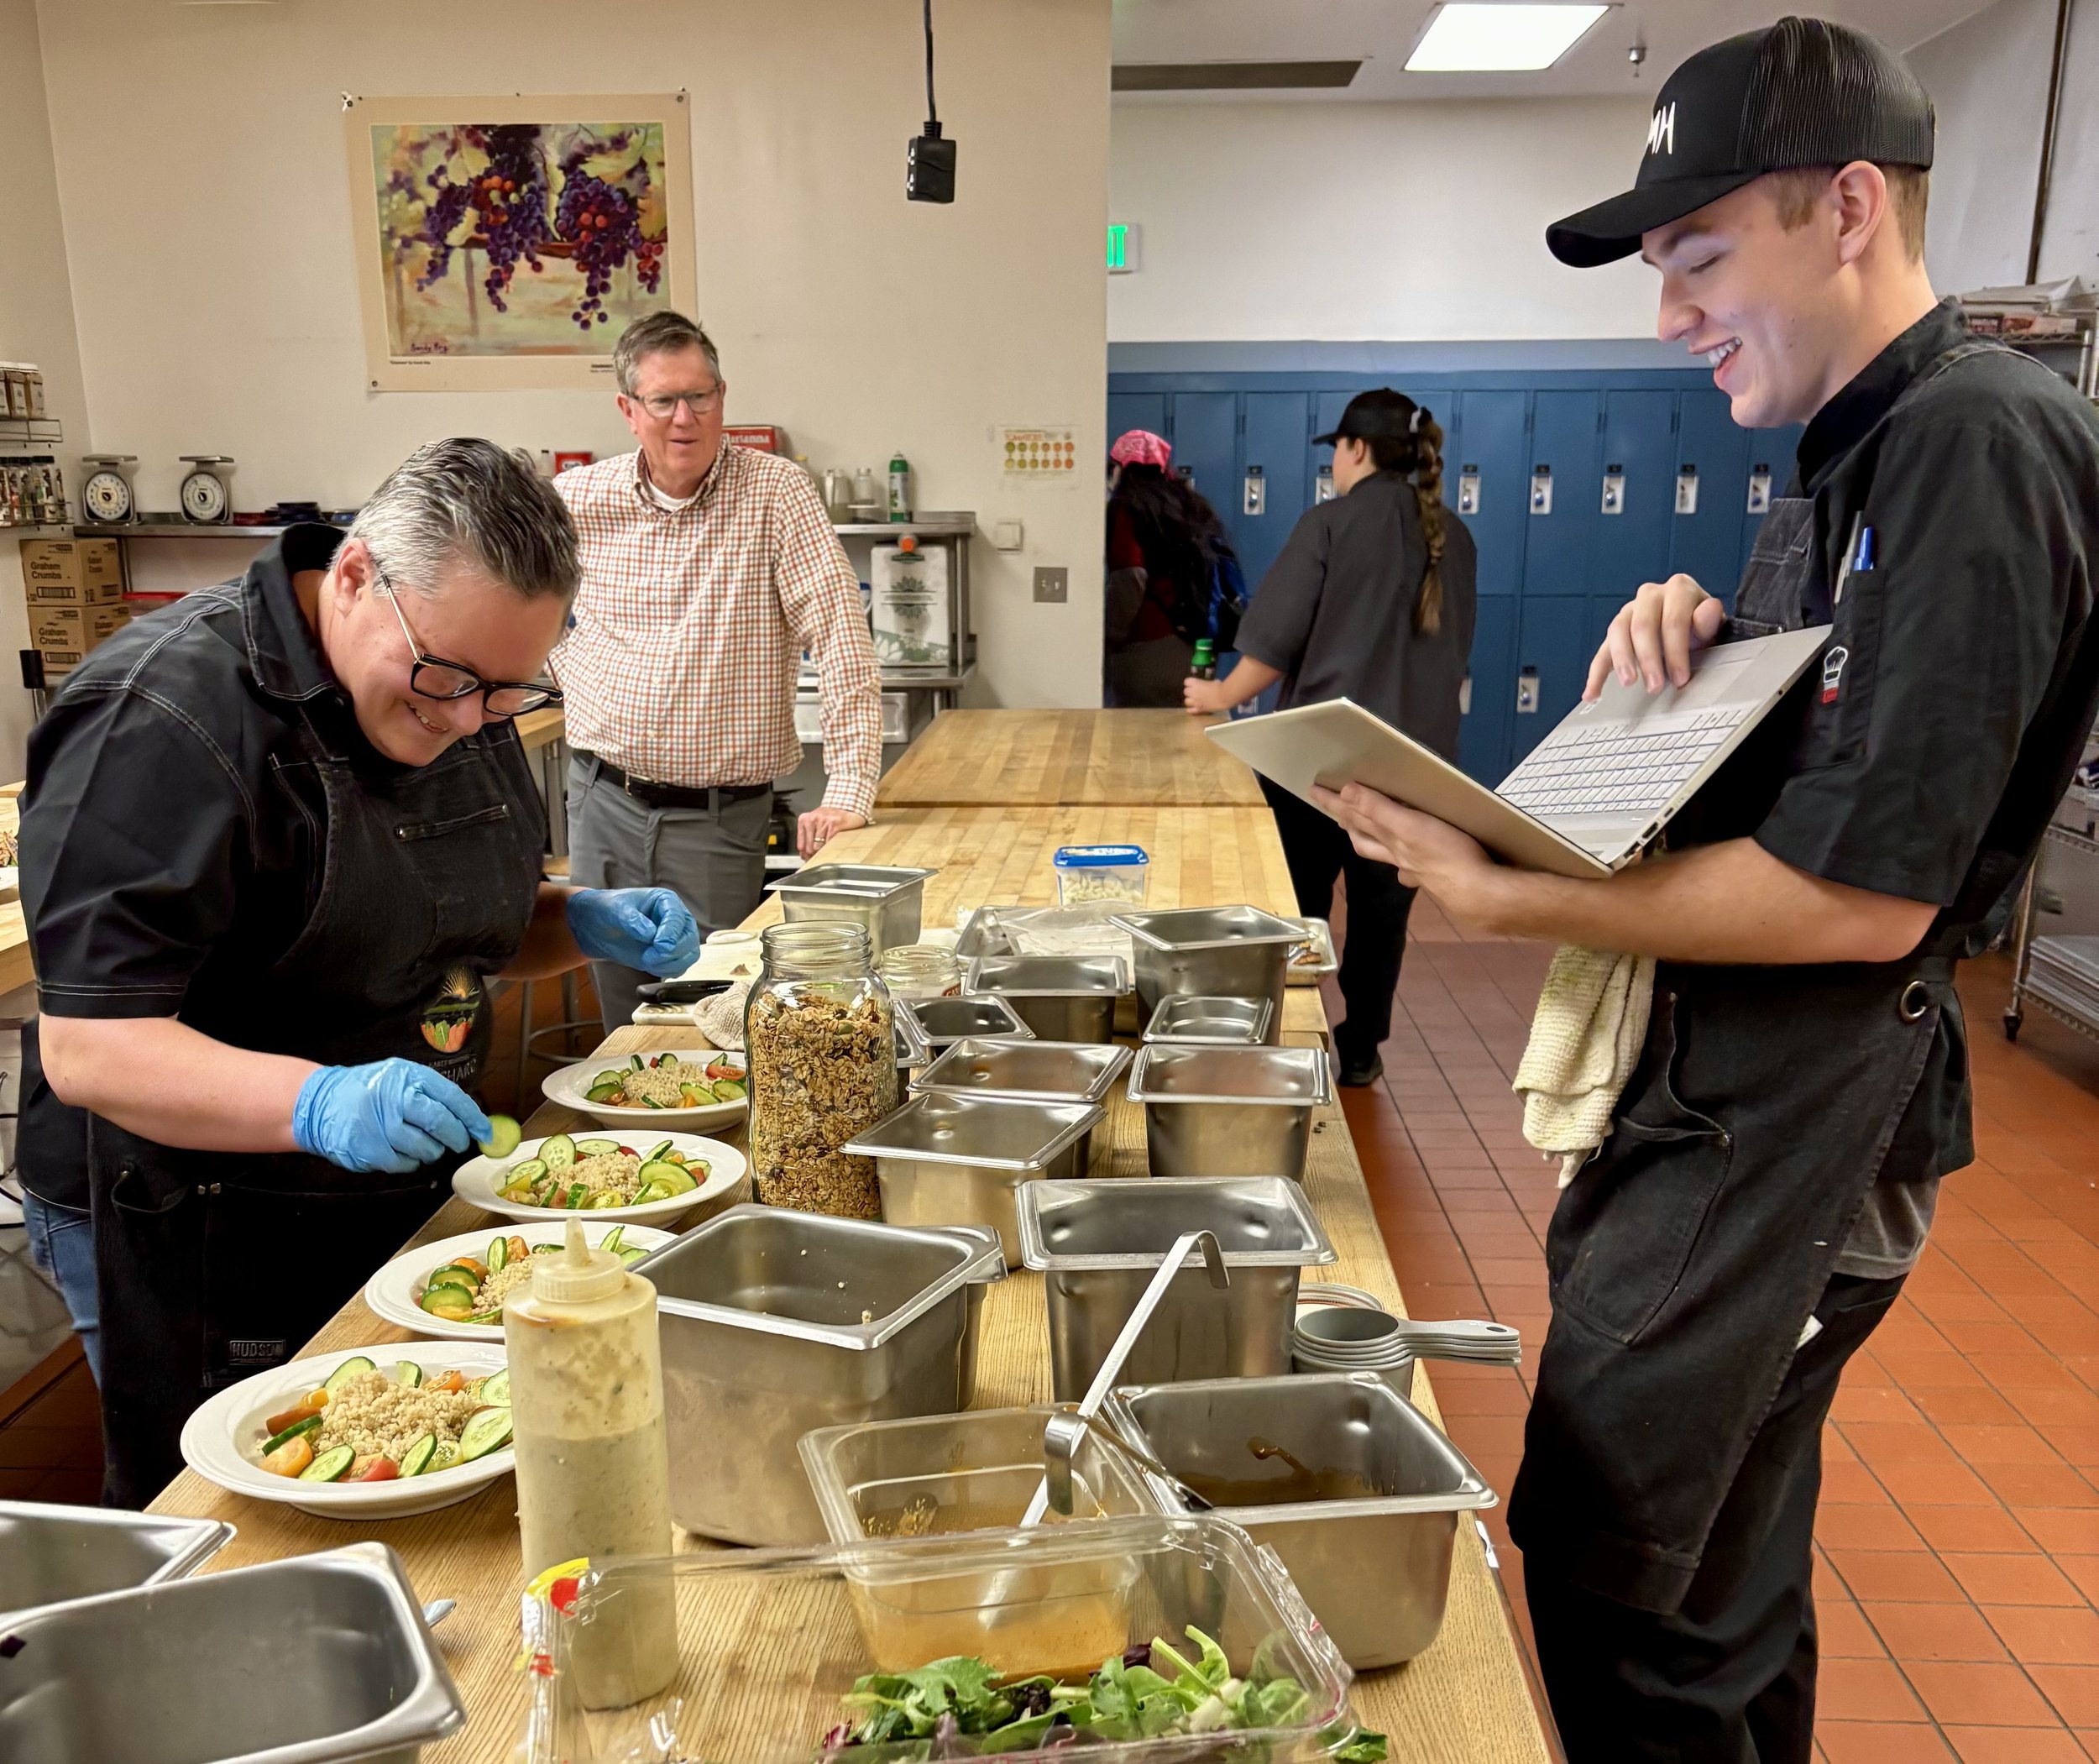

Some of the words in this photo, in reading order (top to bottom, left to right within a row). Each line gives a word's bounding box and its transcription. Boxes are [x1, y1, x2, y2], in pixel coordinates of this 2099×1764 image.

[1107, 225, 1128, 269] IT
[31, 561, 61, 570] Graham
[32, 571, 62, 579] Crumbs
[39, 627, 69, 636] Graham
[39, 636, 69, 646] Crumbs
